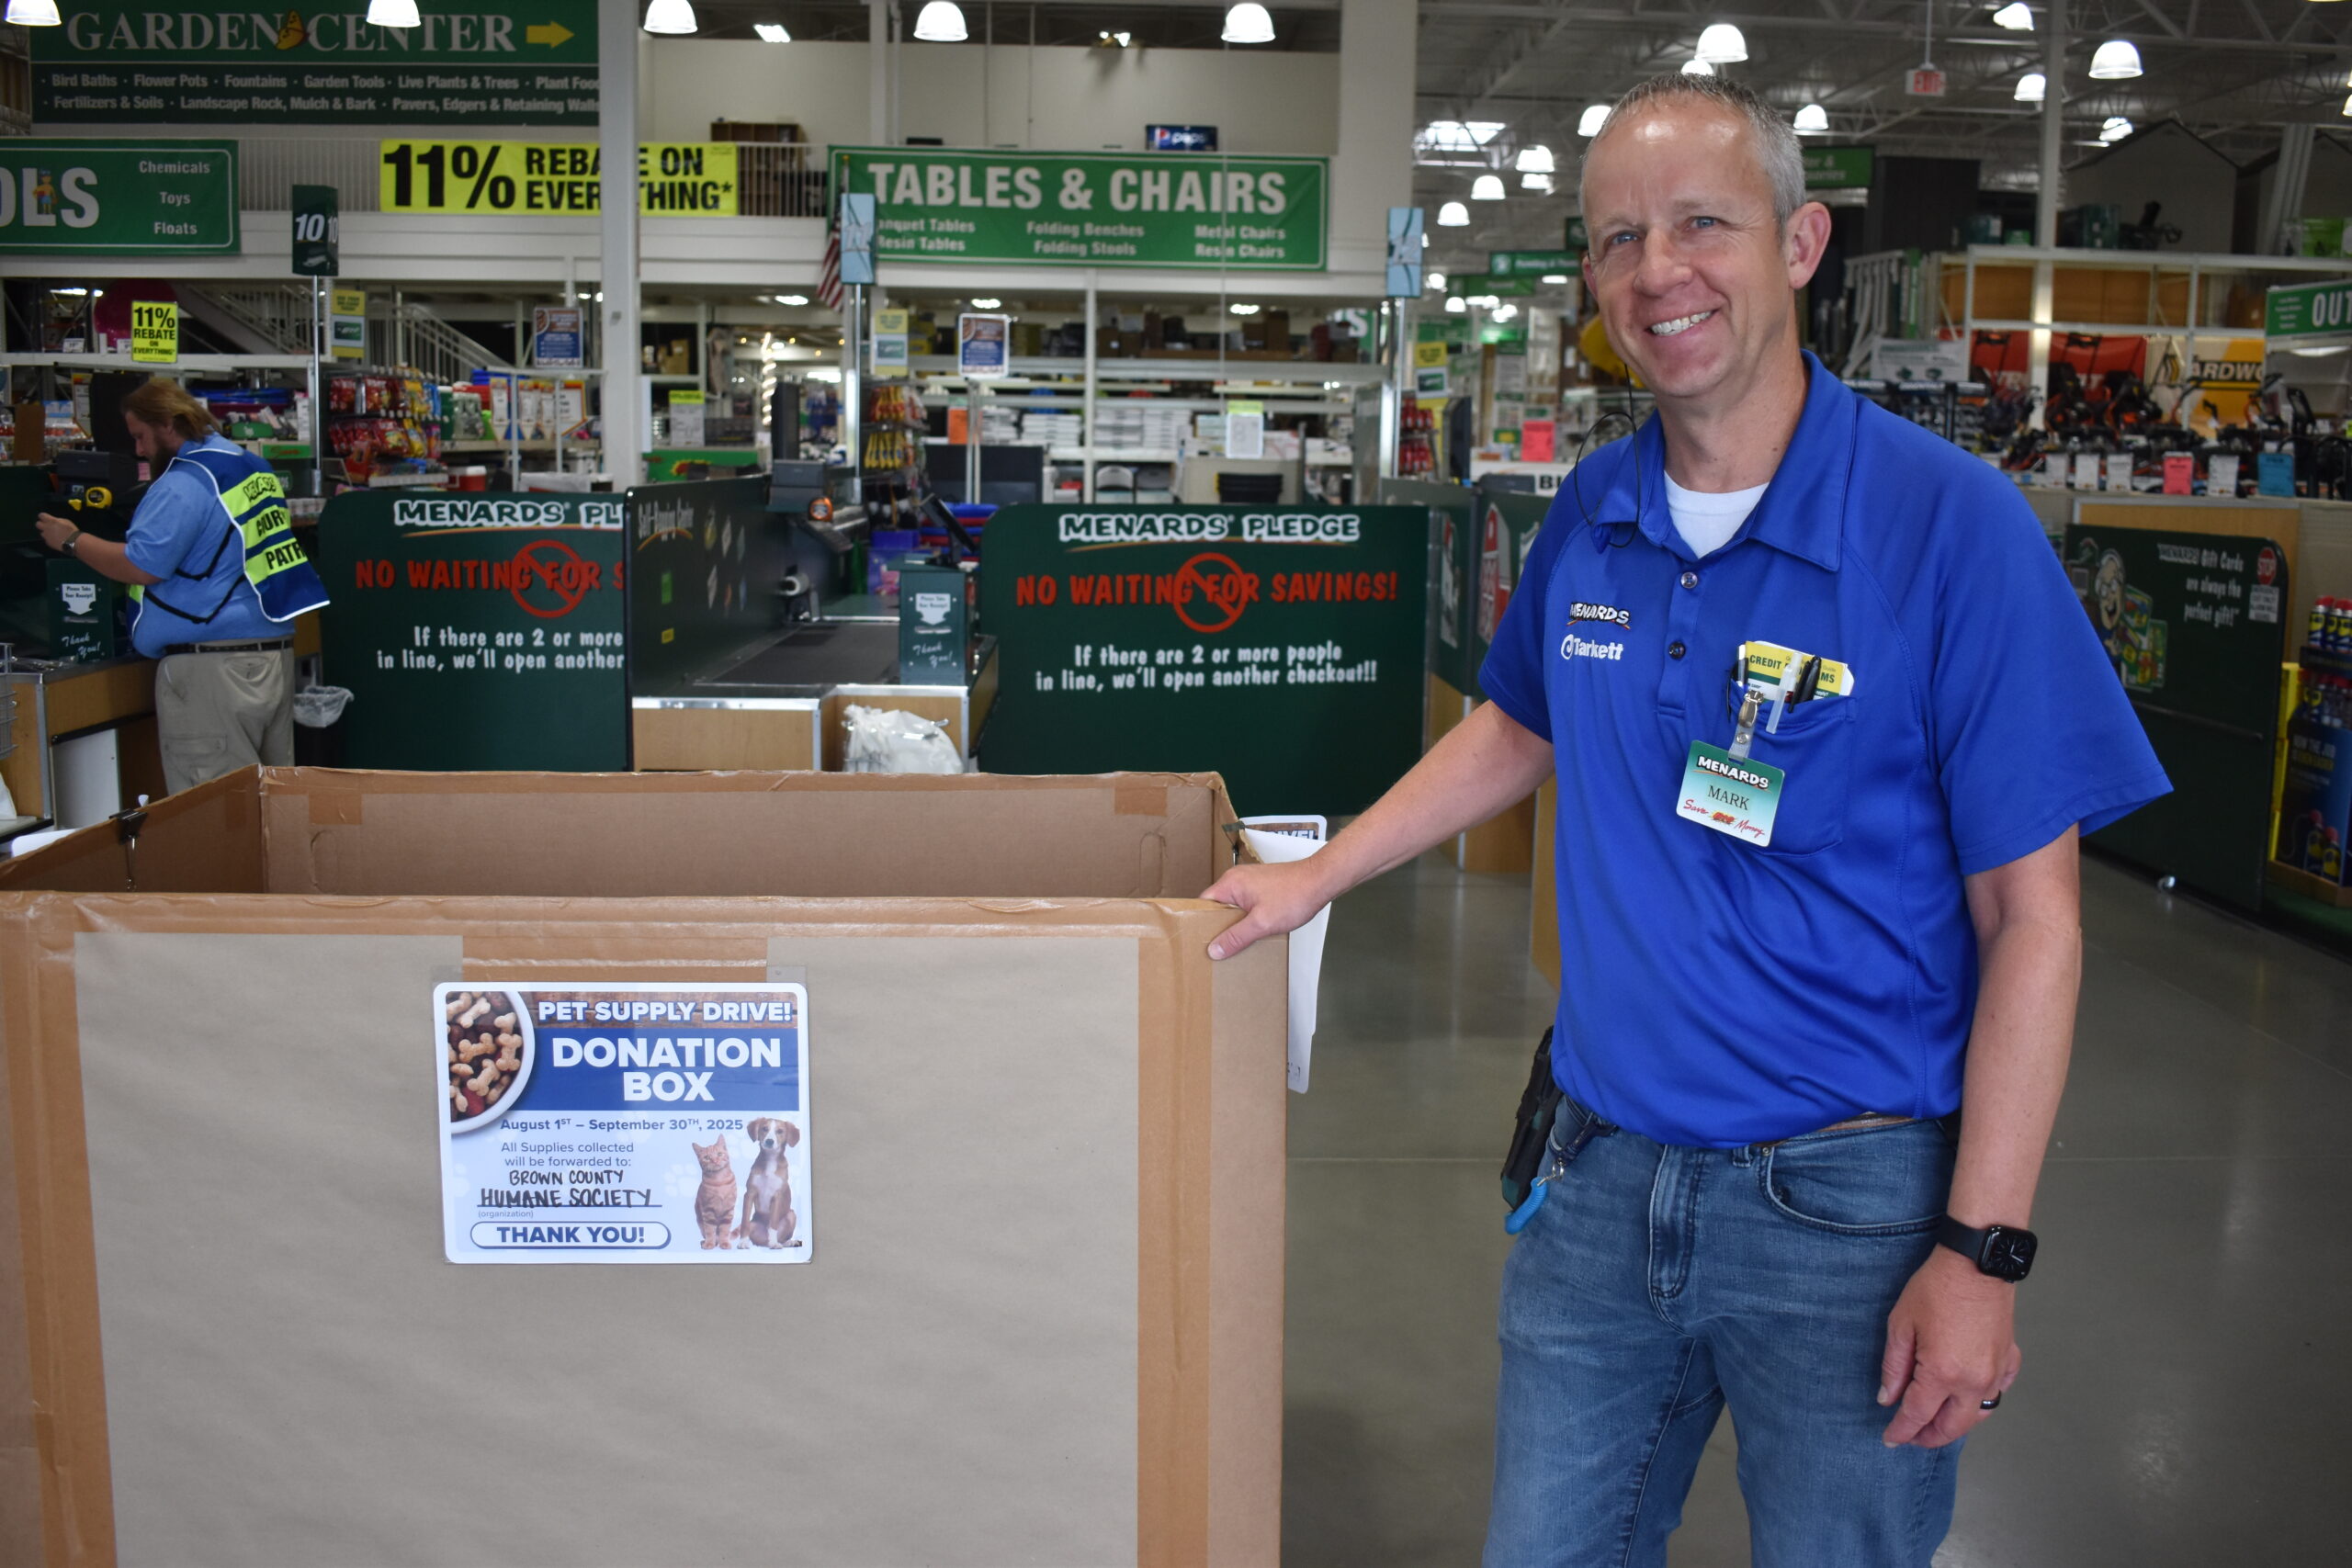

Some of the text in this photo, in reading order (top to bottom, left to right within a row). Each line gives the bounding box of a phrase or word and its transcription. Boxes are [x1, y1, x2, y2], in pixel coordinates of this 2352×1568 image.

[67, 12, 517, 51] GARDEN CENTER
[52, 74, 118, 87] Bird Baths
[134, 74, 208, 88] Flower Pots
[225, 75, 288, 88] Fountains
[304, 75, 385, 89] Garden Tools
[399, 76, 519, 90] Live Plants & Trees
[536, 77, 568, 90] Plant
[54, 96, 164, 109] Fertilizers & Soils
[180, 97, 376, 112] Landscape Rock, Mulch & Bark
[392, 99, 440, 114] Pavers,
[443, 99, 487, 114] Edgers
[491, 99, 499, 111] &
[505, 99, 564, 114] Retaining
[139, 161, 210, 175] Chemicals
[383, 144, 704, 209] 11% REBE ON
[526, 181, 732, 210] EVERHING
[868, 163, 1287, 215] TABLES & CHAIRS
[160, 192, 190, 206] Toys
[154, 221, 197, 235] Floats
[295, 213, 325, 242] 10
[930, 219, 976, 232] Tables
[1026, 220, 1145, 238] Folding Benches
[1195, 224, 1286, 240] Metal Chairs
[920, 237, 966, 251] Tables
[1035, 240, 1137, 257] Folding Stools
[1195, 243, 1285, 258] Resin Chairs
[2312, 289, 2352, 327] OUT
[134, 307, 175, 328] 11%
[134, 328, 175, 340] REBATE
[580, 502, 622, 528] PL
[1242, 513, 1360, 542] PLEDGE
[266, 542, 306, 570] PATR
[2221, 550, 2244, 572] Cards
[355, 559, 601, 590] NO WAITING FOR
[2257, 558, 2277, 578] STOP
[1016, 571, 1397, 606] NO WAITING FOR SAVINGS!
[1569, 602, 1631, 626] MENARDS
[62, 632, 90, 647] Thank
[414, 626, 623, 648] If there are 2 or more
[78, 641, 101, 659] You!
[1075, 640, 1342, 667] If there are 2 or more people
[1574, 637, 1623, 660] Tarkett
[377, 648, 624, 673] in line, we'll open another
[1749, 654, 1782, 670] CREDIT
[1036, 660, 1377, 693] in line, we'll open another checkout!!
[1698, 754, 1770, 789] MENARDS
[1707, 785, 1750, 810] MARK
[1683, 798, 1766, 839] Save Money
[539, 1001, 793, 1021] PET SUPPLY DRIVE!
[553, 1037, 781, 1068] DONATION
[624, 1071, 715, 1101] BOX
[501, 1118, 743, 1133] August 1ST September 30TH, 2025
[501, 1142, 634, 1156] All Supplies collected
[504, 1156, 631, 1167] will be forwarded to:
[510, 1169, 624, 1185] BROWN COUNTY
[481, 1188, 651, 1209] HUMANE SOCIETY
[478, 1209, 534, 1219] (organization)
[496, 1227, 645, 1243] THANK YOU!
